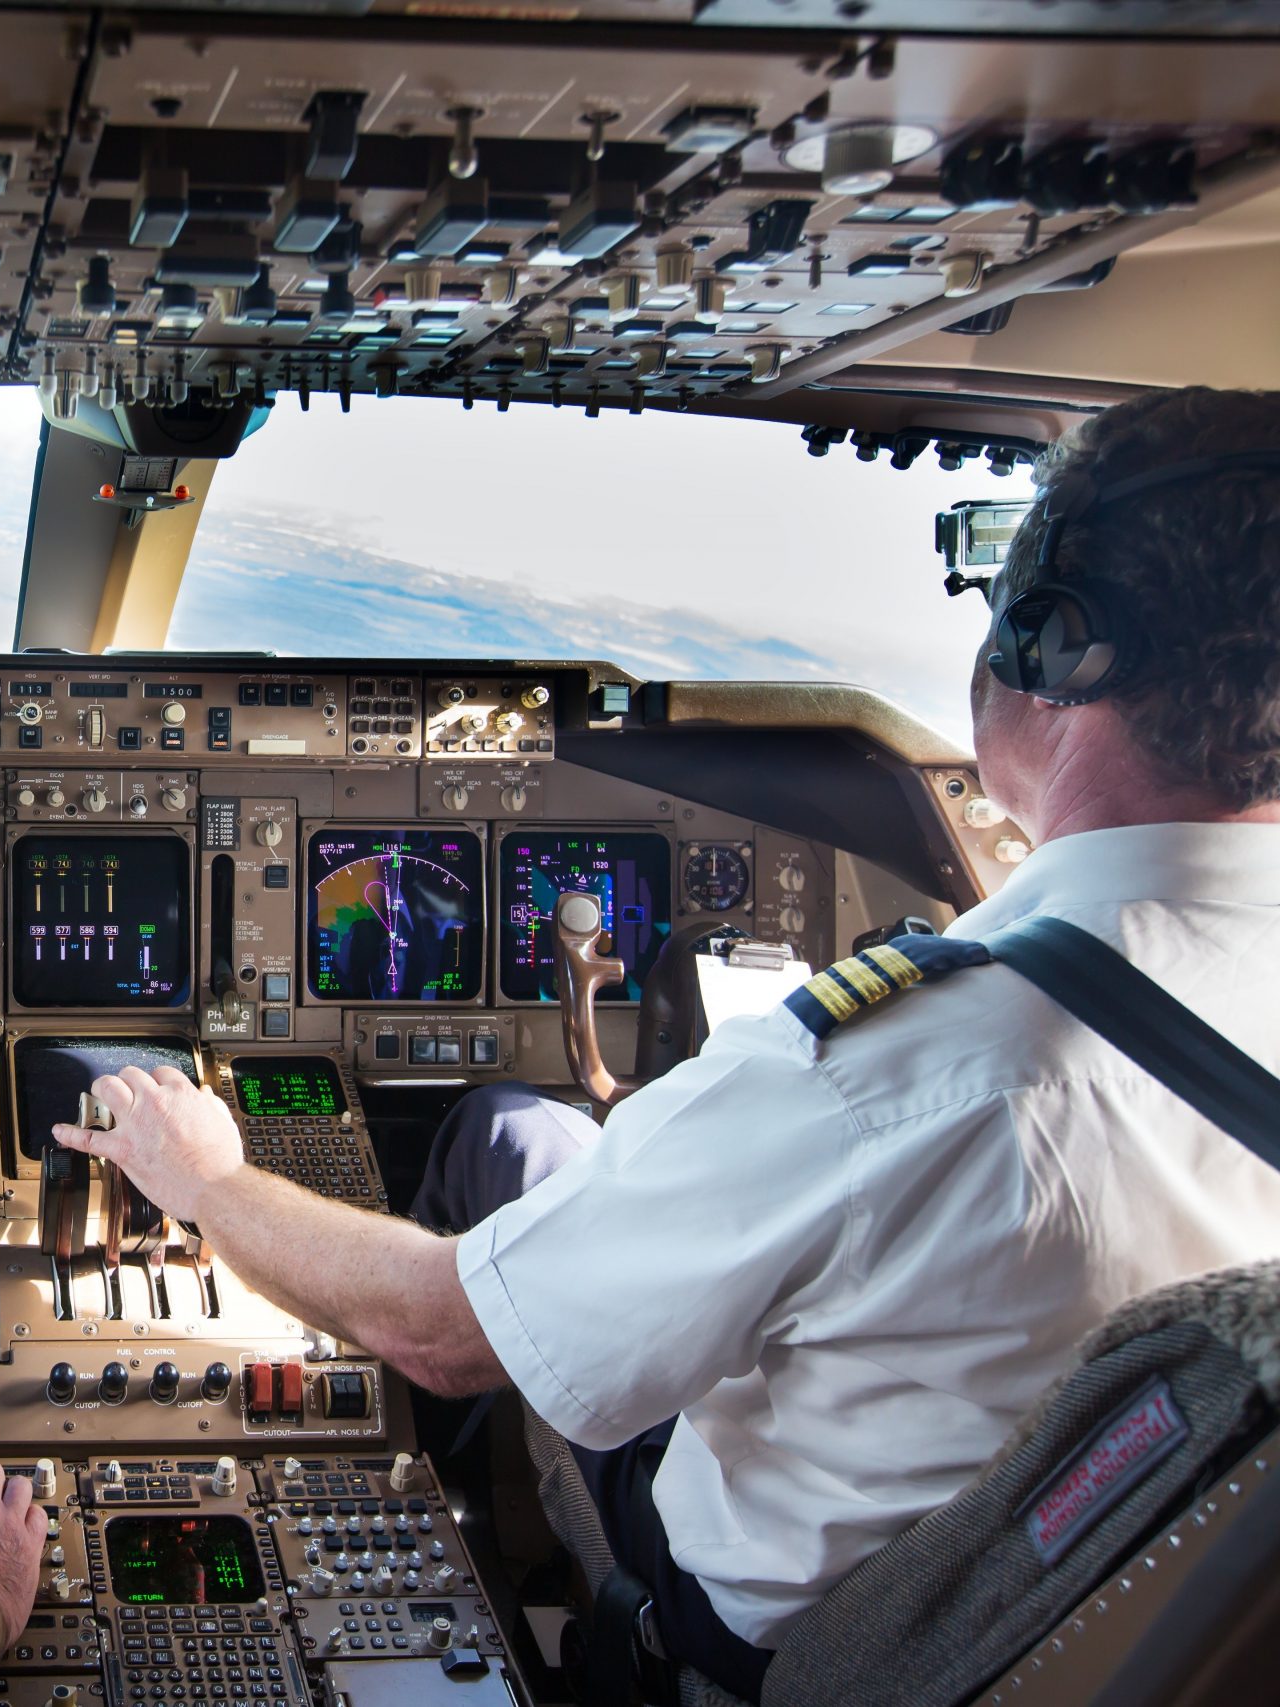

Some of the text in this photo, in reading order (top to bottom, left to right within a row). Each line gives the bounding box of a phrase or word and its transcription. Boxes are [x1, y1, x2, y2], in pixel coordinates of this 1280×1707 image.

[210, 1023, 247, 1032] DM-BE
[94, 1107, 99, 1118] 1
[1036, 1465, 1090, 1522] REMOVE
